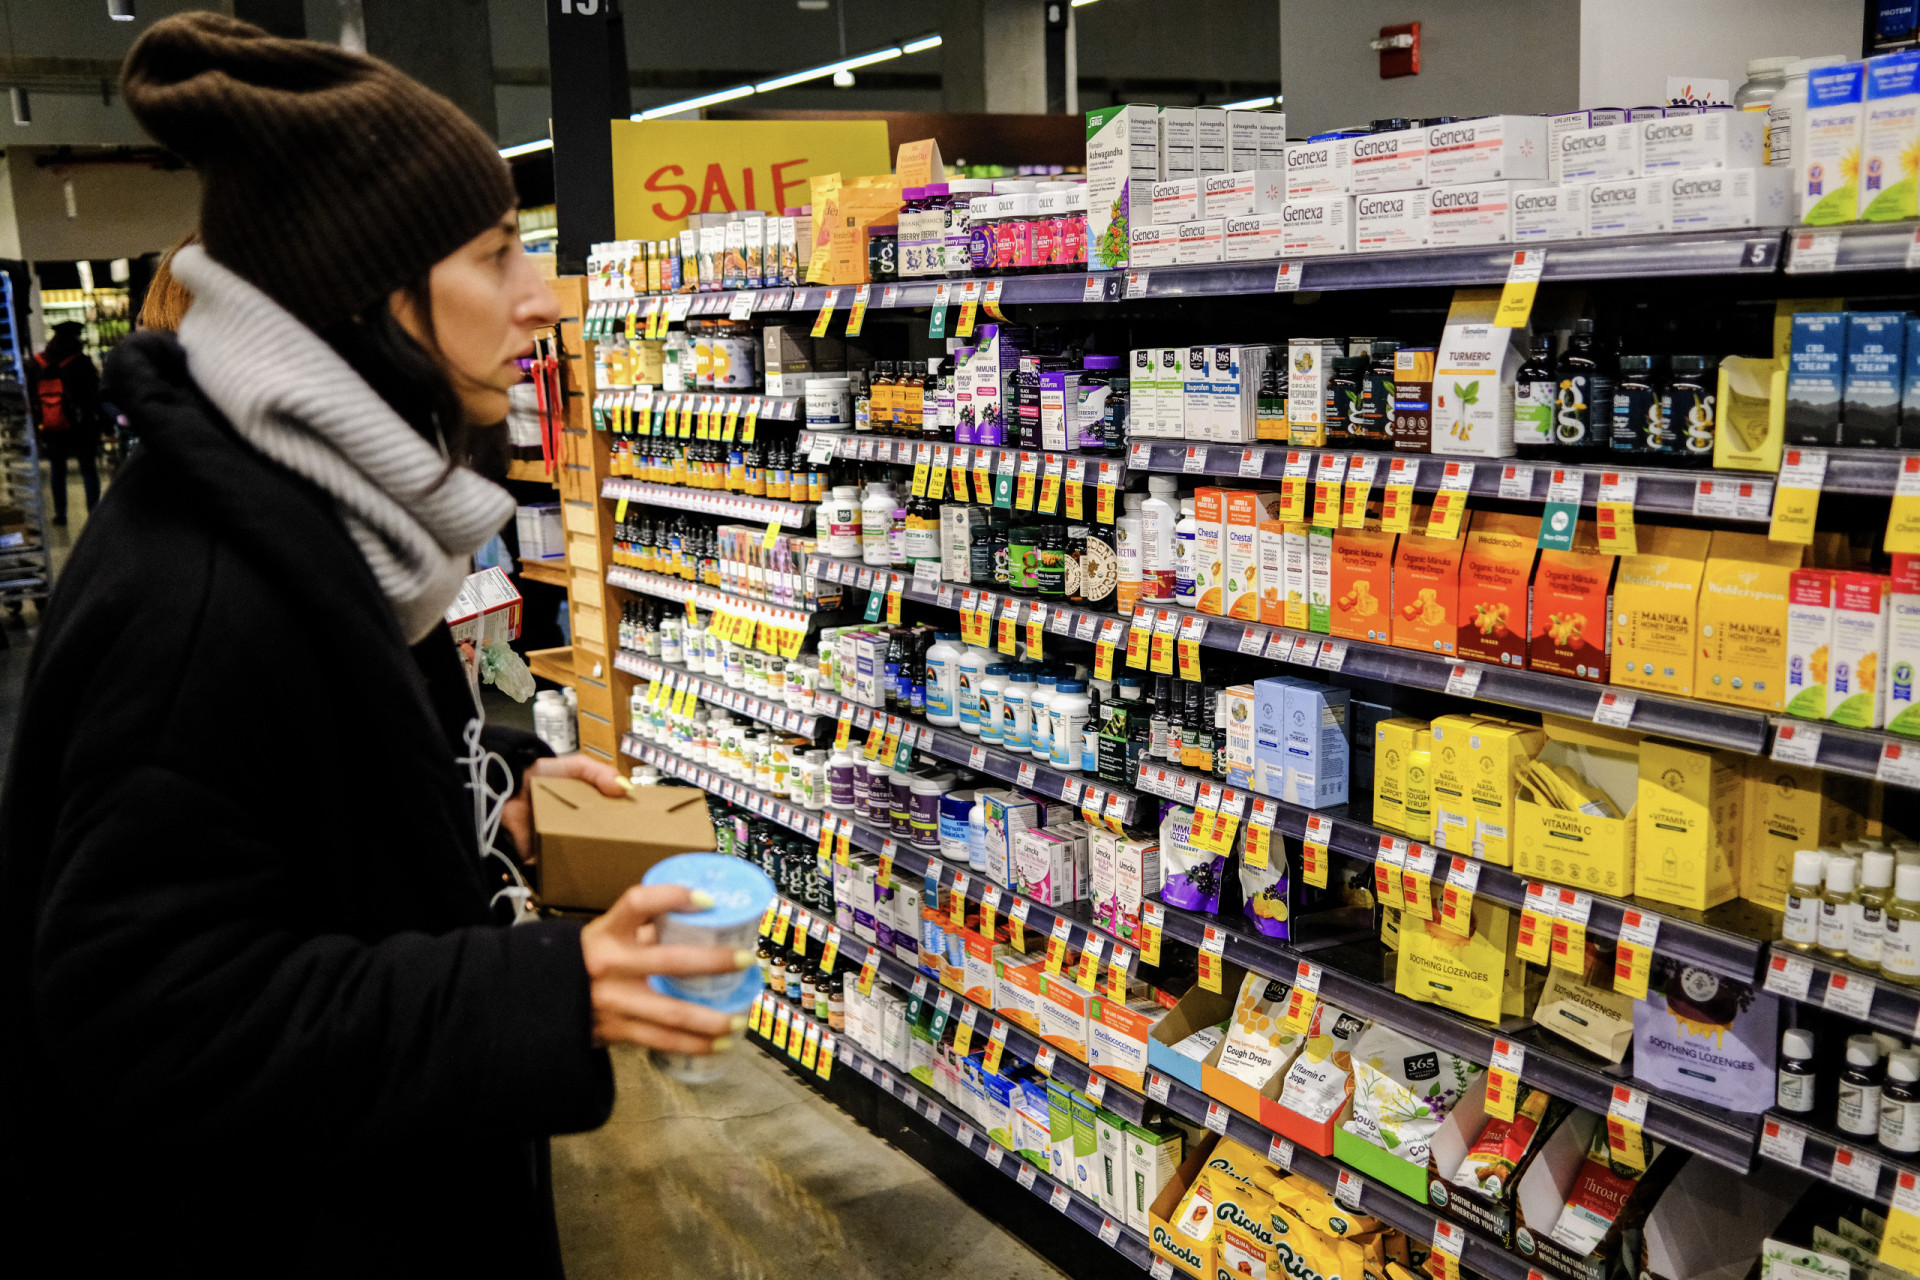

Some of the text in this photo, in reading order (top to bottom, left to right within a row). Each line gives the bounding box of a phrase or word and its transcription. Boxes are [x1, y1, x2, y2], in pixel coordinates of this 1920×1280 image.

[1880, 6, 1912, 17] PROTEIN
[1430, 125, 1475, 148] Genexa
[1644, 122, 1693, 142] Genexa
[1354, 137, 1398, 157] Genexa
[1562, 134, 1607, 153] Genexa
[1089, 149, 1123, 160] Ashwagandha
[1288, 149, 1328, 167] Genexa
[1206, 177, 1236, 191] Genexa
[1672, 178, 1722, 196] Genexa
[1153, 184, 1180, 198] Genexa
[1591, 186, 1636, 205] Genexa
[1432, 189, 1479, 208] Genexa
[1515, 194, 1557, 211] Genexa
[1359, 197, 1404, 216] Genexa
[1283, 205, 1324, 222] Genexa
[1179, 225, 1205, 239] Genexa
[1227, 218, 1260, 233] Genexa
[1132, 228, 1160, 242] Genexa
[1751, 244, 1767, 264] 5
[1138, 354, 1147, 362] 365
[1164, 354, 1174, 362] 365
[1191, 352, 1202, 363] 365
[1216, 352, 1229, 363] 365
[1449, 352, 1492, 362] TURMERIC
[1792, 353, 1838, 362] SOOTHING
[1798, 362, 1830, 372] CREAM
[1855, 363, 1888, 372] CREAM
[1186, 384, 1209, 392] Ibuprofen
[1212, 385, 1236, 393] Ibuprofen
[1198, 528, 1218, 539] Chestal
[1230, 532, 1252, 542] Chestal
[1338, 546, 1364, 557] Organic
[1342, 556, 1377, 568] Honey Drops
[1403, 553, 1429, 564] Organic
[1406, 563, 1444, 575] Honey Drops
[1469, 562, 1494, 573] Organic
[1473, 572, 1513, 585] Honey Drops
[1622, 572, 1692, 592] Wedderspoon
[1708, 582, 1785, 602] Wedderspoon
[1641, 611, 1689, 626] MANUKA
[1640, 620, 1688, 634] HONEY DROPS
[1728, 622, 1781, 637] MANUKA
[1480, 638, 1499, 646] GINGER
[1650, 633, 1676, 642] LEMON
[1728, 632, 1757, 643] HONEY
[1554, 649, 1574, 658] GINGER
[1740, 644, 1767, 655] LEMON
[1260, 726, 1277, 736] THROAT
[1230, 736, 1250, 750] THROAT
[1290, 734, 1308, 743] THROAT
[1434, 778, 1450, 787] SPRAY
[1440, 773, 1458, 782] NASAL
[1384, 781, 1398, 790] SINUS
[1476, 783, 1496, 792] NASAL
[1380, 787, 1402, 798] SUPPORT
[1406, 792, 1430, 801] COUGH
[1472, 788, 1487, 797] SPRAY
[1407, 798, 1428, 808] SYRUP
[1172, 824, 1190, 834] IMMU
[1542, 818, 1592, 836] VITAMIN C
[1688, 820, 1695, 828] C
[1024, 845, 1038, 857] Umcka
[1096, 848, 1110, 860] Umcka
[1120, 862, 1136, 874] Umcka
[1409, 952, 1488, 983] SOOTHING LOZENGES
[1553, 984, 1622, 1022] SOOTHING LOZENGES
[1042, 1002, 1080, 1027] Oscillococcinum
[1336, 1018, 1359, 1033] 365
[1094, 1028, 1141, 1055] Oscillococcinum
[1241, 1041, 1254, 1050] Lemon
[1254, 1045, 1270, 1054] Flavor
[1091, 1048, 1099, 1058] 30
[1226, 1045, 1272, 1067] Cough Drops
[1649, 1035, 1755, 1072] SOOTHING LOZENGES
[1408, 1058, 1435, 1072] 365
[1294, 1062, 1326, 1082] Vitamin C
[1314, 1104, 1332, 1117] 30
[1353, 1110, 1376, 1131] Coug
[1404, 1136, 1424, 1146] Herbal
[1585, 1177, 1618, 1203] Throat
[1450, 1191, 1506, 1229] SOOTHE NATURALLY,
[1450, 1202, 1493, 1231] WHEREVER YOU
[1216, 1201, 1274, 1245] Ricola
[1153, 1225, 1203, 1270] Ricola
[1226, 1234, 1265, 1260] ORIGINAL HERB
[1538, 1240, 1600, 1280] SOOTHE NATURALLY,
[1538, 1250, 1570, 1274] WHEREVER
